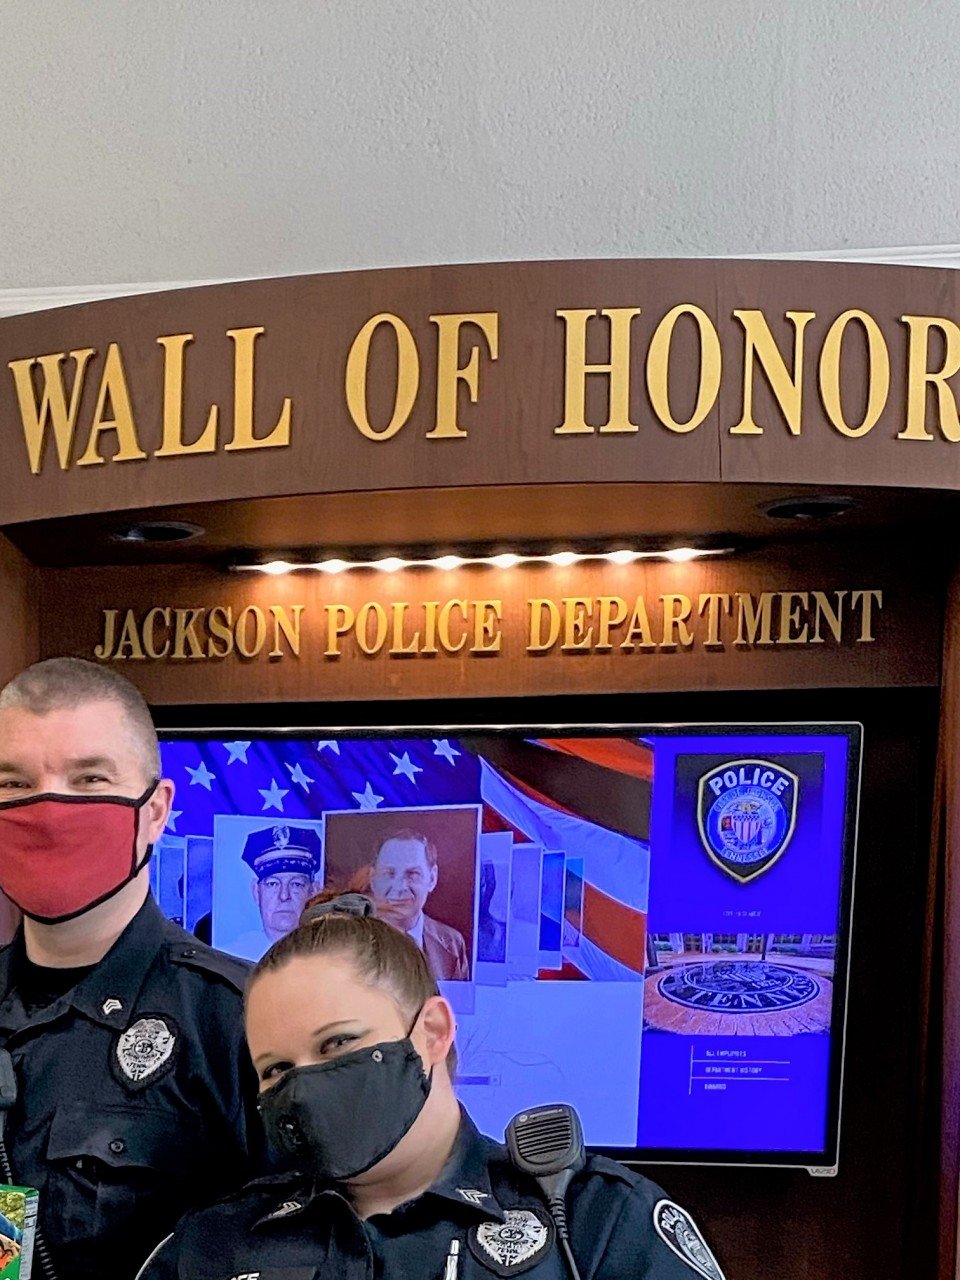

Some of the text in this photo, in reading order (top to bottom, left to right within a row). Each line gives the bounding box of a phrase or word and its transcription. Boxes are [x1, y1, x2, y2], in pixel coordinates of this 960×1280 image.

[8, 302, 960, 475] WALL OF HONOR
[94, 589, 883, 660] JACKSON POLICE DEPARTMENT
[708, 767, 790, 796] POLICE
